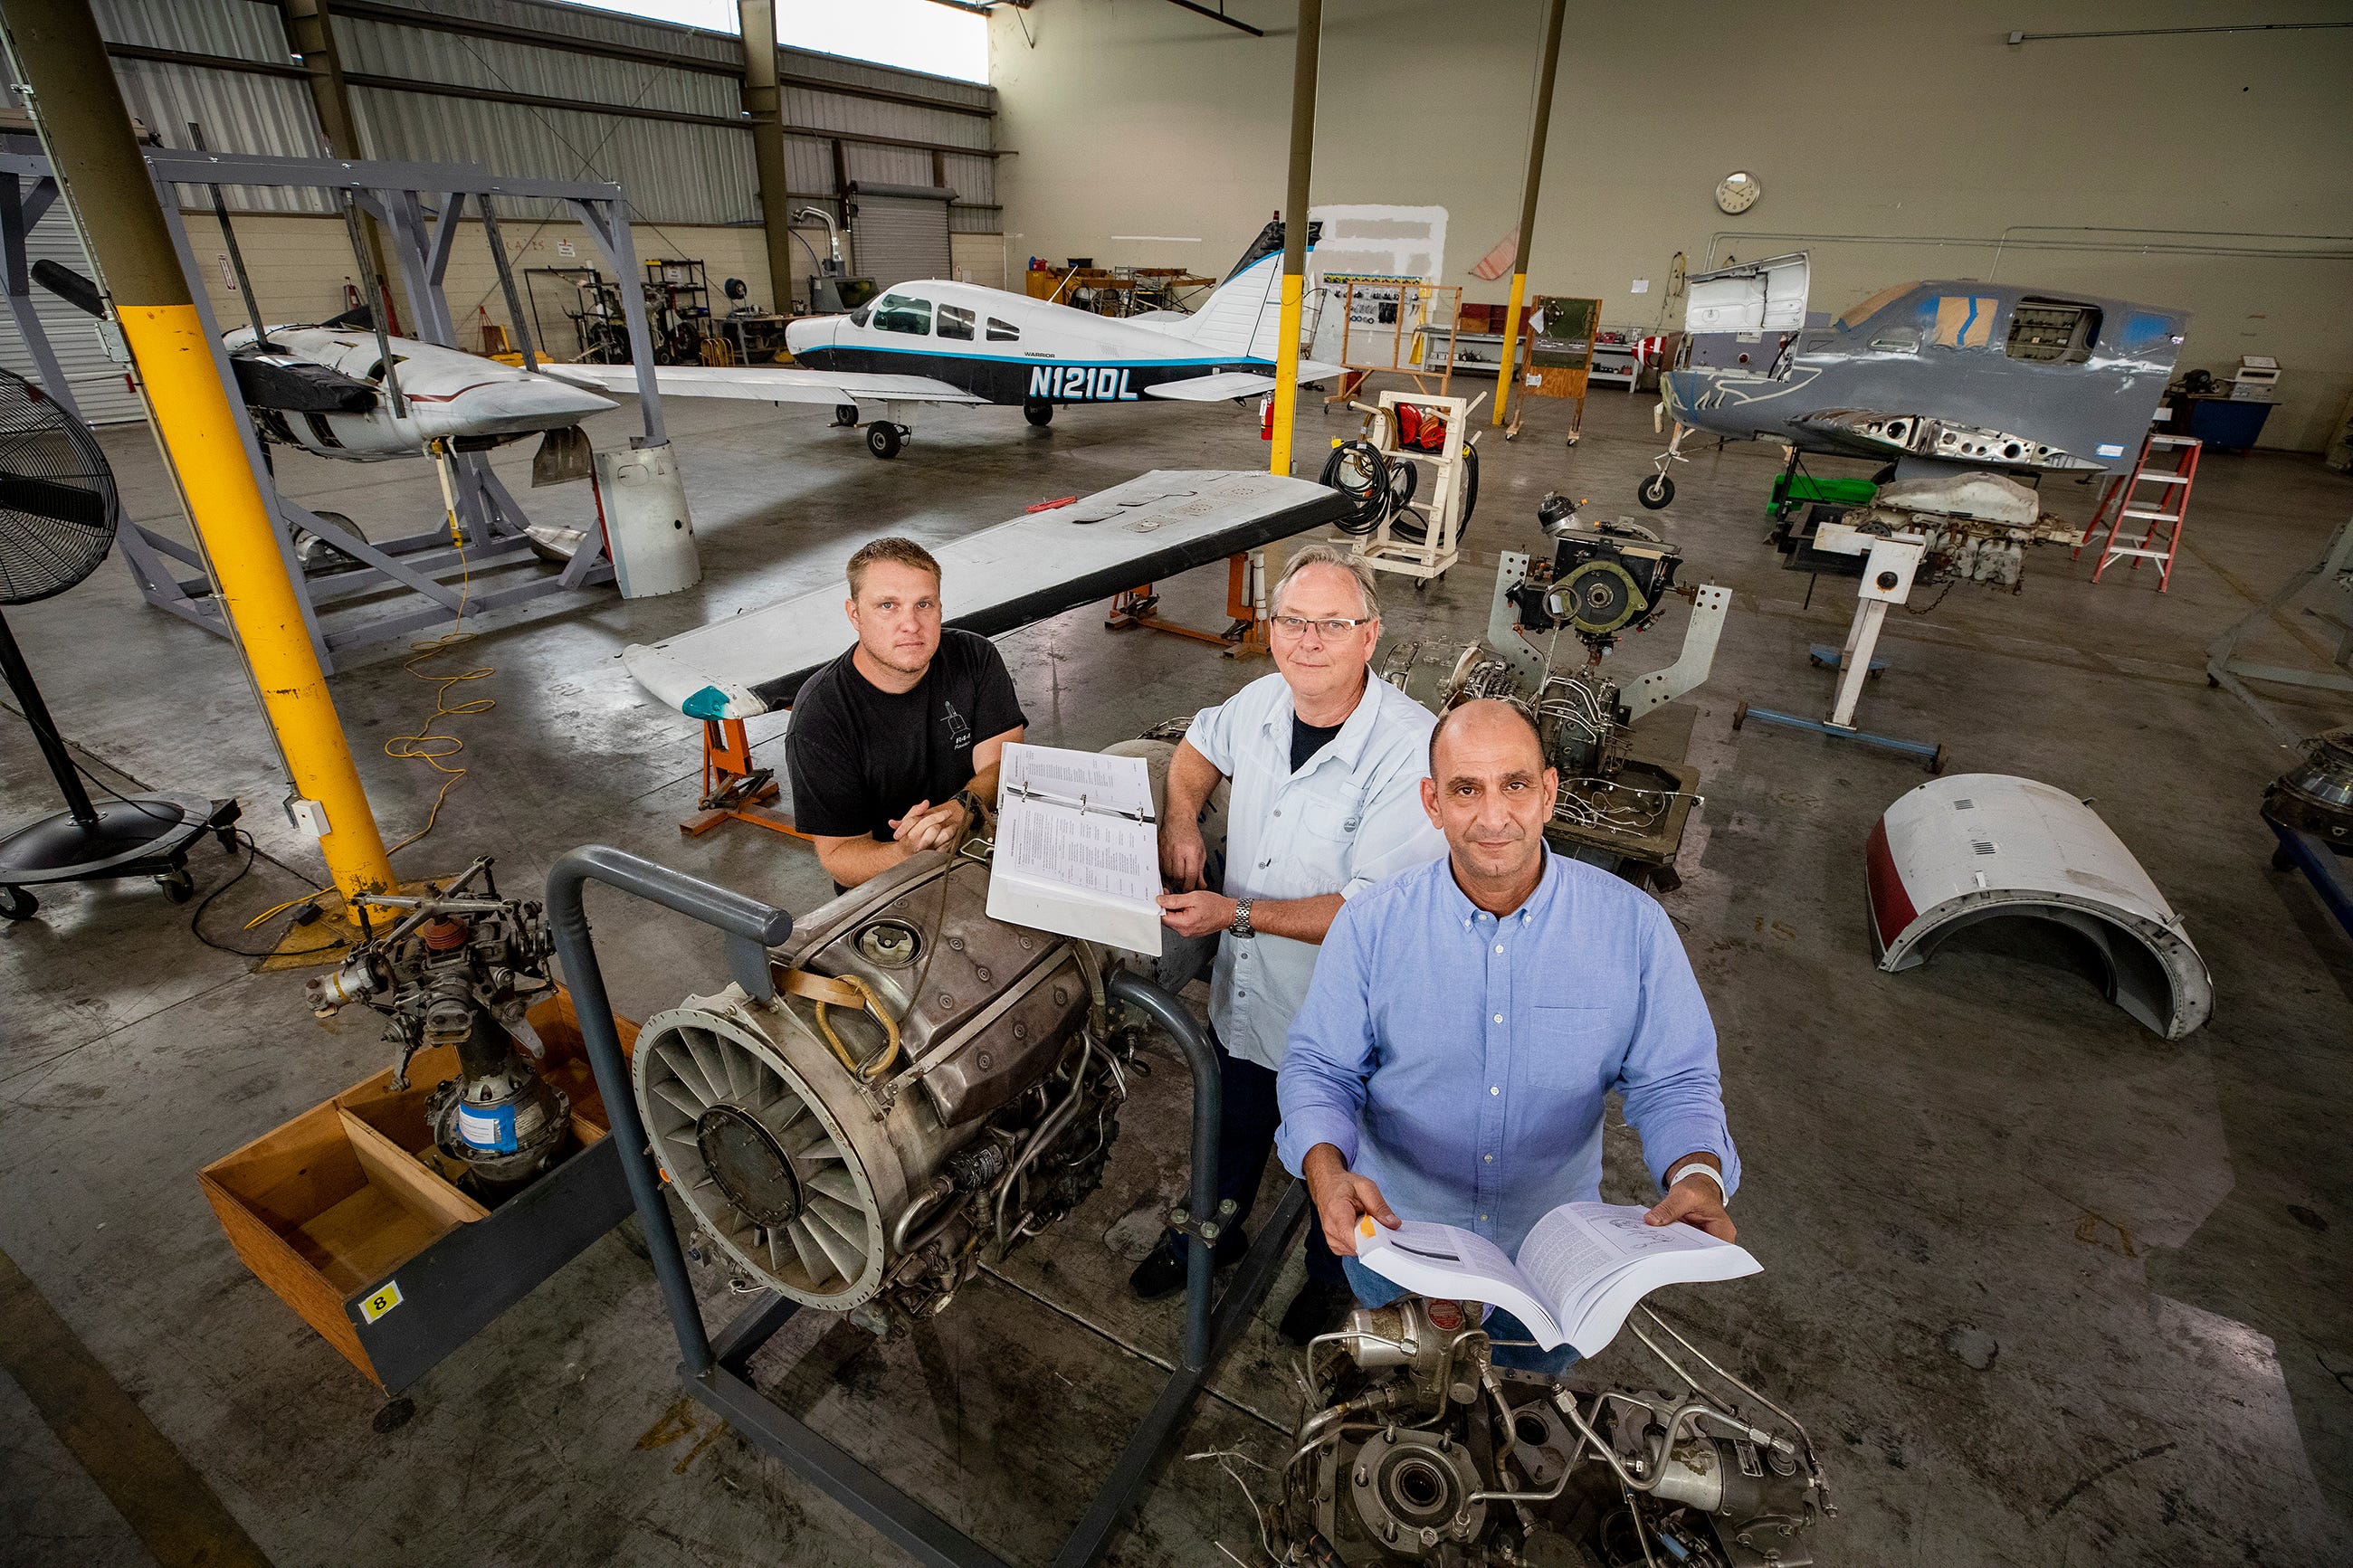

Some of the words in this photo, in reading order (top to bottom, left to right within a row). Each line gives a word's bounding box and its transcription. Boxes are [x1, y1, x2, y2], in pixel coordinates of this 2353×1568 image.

[1029, 366, 1138, 401] N121DL
[956, 733, 971, 744] R44
[374, 1296, 387, 1311] 8
